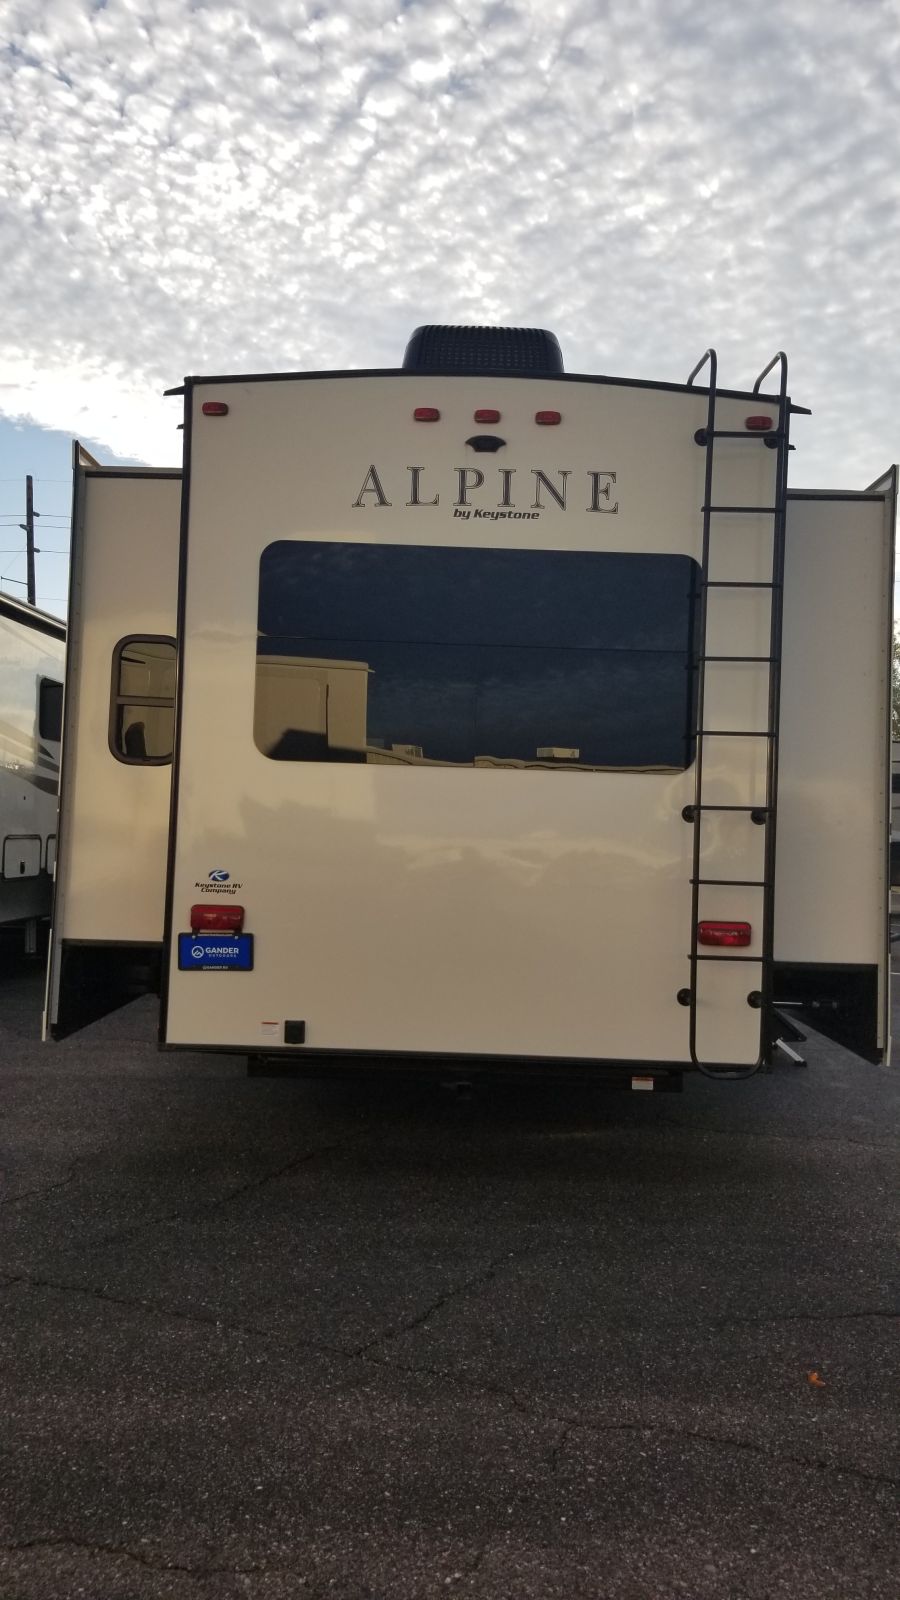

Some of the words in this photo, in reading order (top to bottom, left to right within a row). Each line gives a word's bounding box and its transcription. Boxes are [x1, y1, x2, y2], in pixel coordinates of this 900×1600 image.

[351, 464, 619, 514] ALPINE
[453, 509, 471, 520] by
[474, 509, 540, 521] Keystone
